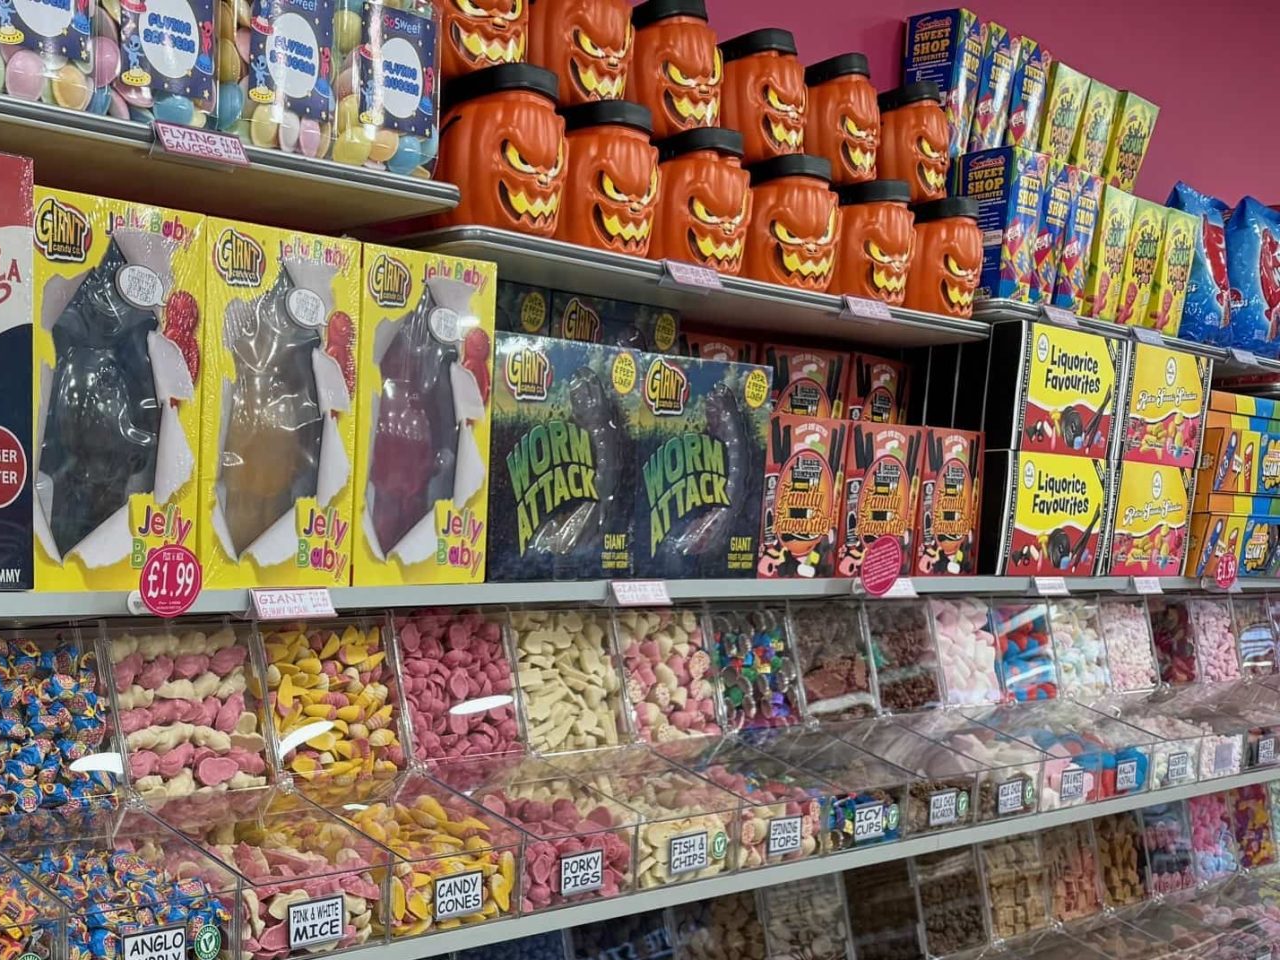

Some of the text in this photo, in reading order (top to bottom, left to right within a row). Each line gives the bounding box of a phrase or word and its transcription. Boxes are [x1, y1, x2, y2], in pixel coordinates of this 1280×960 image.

[914, 28, 951, 43] SWEET
[913, 40, 950, 56] SHOP
[161, 126, 216, 147] FLYING
[166, 138, 220, 158] SAUCERS
[968, 167, 1004, 181] SWEET
[968, 178, 1004, 194] SHOP
[1050, 344, 1099, 375] Liquorice
[1044, 368, 1101, 395] Favourites
[506, 420, 592, 502] WORM
[642, 432, 725, 508] WORM
[1037, 470, 1087, 496] Liquorice
[517, 464, 599, 558] ATTACK
[650, 472, 731, 559] ATTACK
[1032, 493, 1089, 516] Favourites
[137, 502, 193, 546] Jelly
[303, 507, 348, 549] Jelly
[441, 504, 485, 547] Jelly
[604, 534, 626, 550] GIANT
[731, 537, 752, 551] GIANT
[296, 539, 347, 583] Baby
[436, 538, 483, 577] Baby
[147, 560, 195, 599] £1.99
[856, 809, 881, 822] ICY
[855, 820, 882, 835] CUPS
[671, 838, 705, 857] FISH &
[771, 833, 799, 850] TOPS
[564, 855, 600, 875] PORKY
[672, 852, 706, 871] CHIPS
[437, 877, 478, 899] CANDY
[563, 870, 601, 890] PIGS
[292, 900, 339, 925] PINK & WHITE
[437, 893, 481, 915] CONES
[293, 920, 340, 942] MICE
[129, 933, 185, 956] ANGLO
